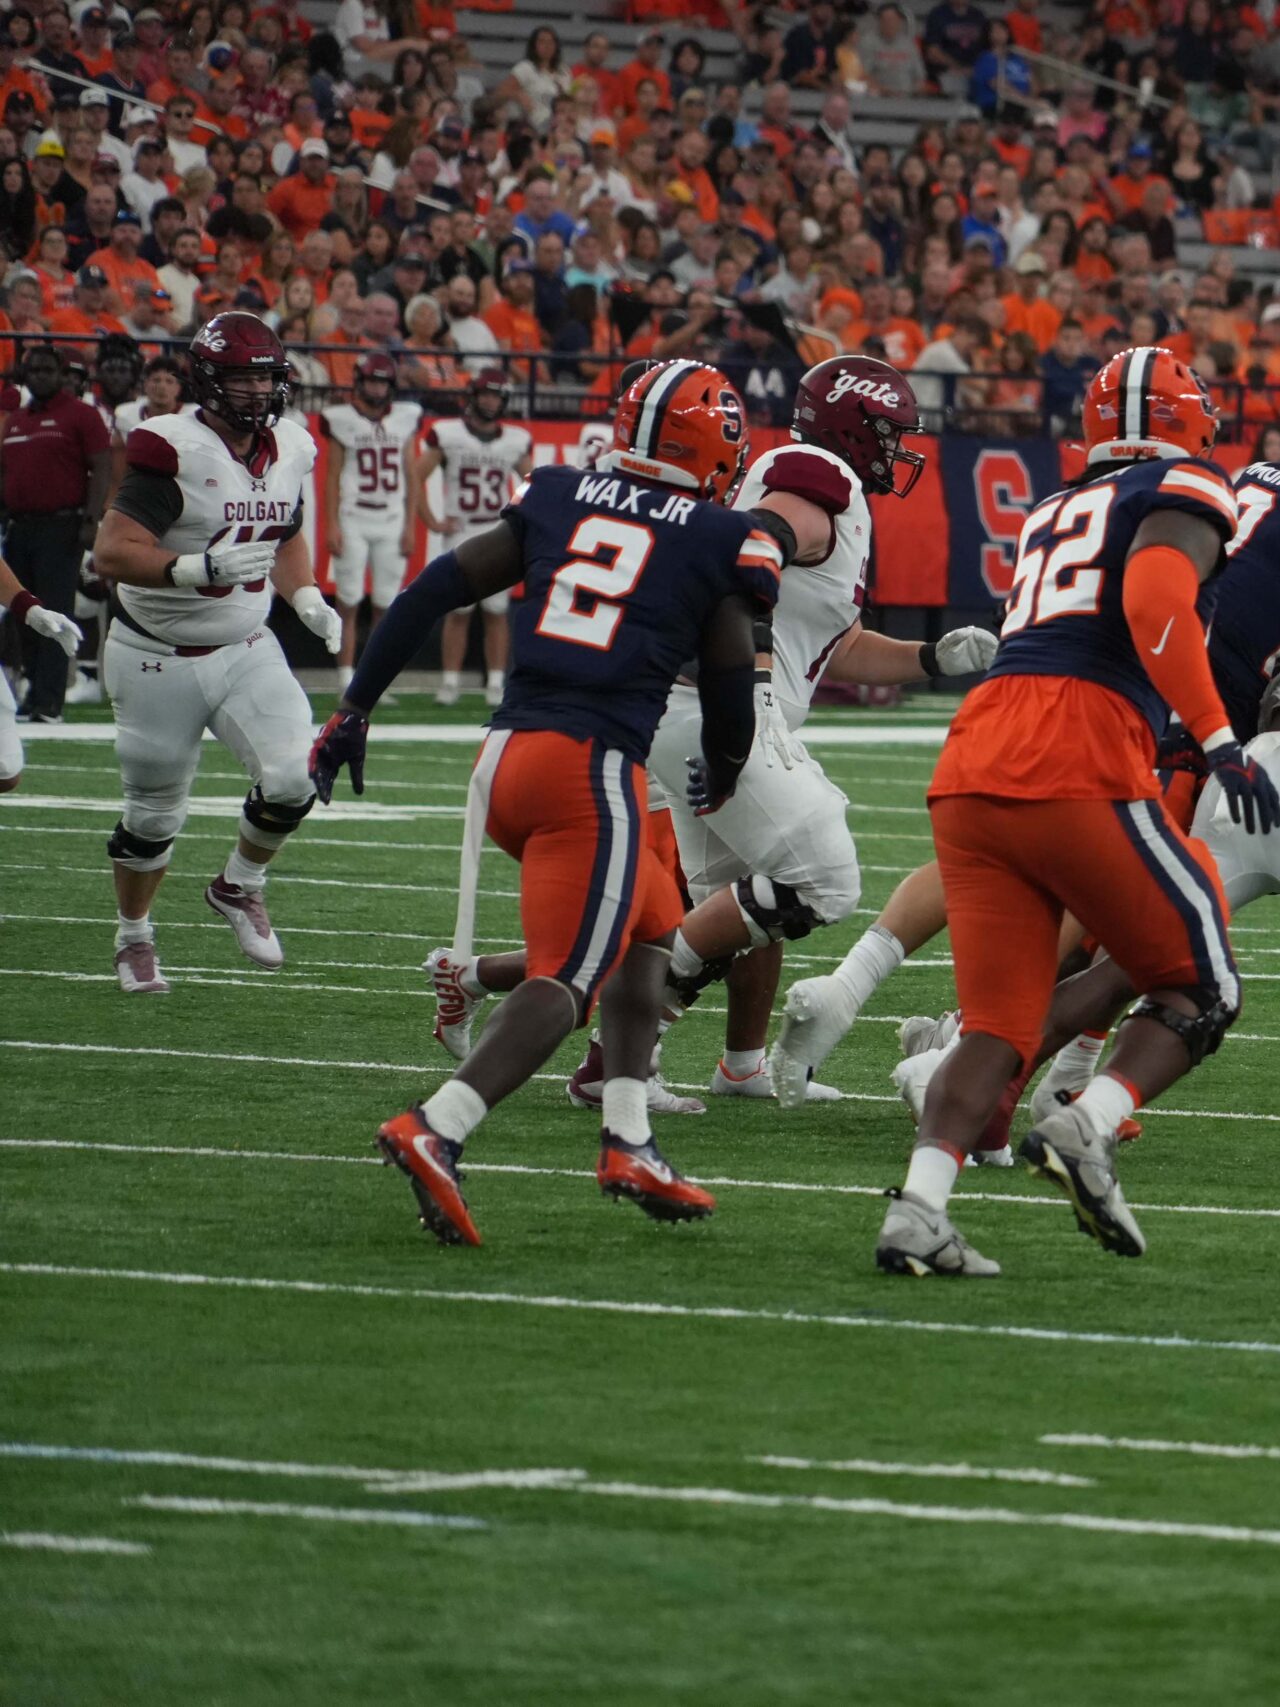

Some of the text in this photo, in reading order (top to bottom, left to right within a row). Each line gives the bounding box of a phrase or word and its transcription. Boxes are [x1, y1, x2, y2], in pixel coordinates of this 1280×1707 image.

[356, 447, 399, 492] 95
[458, 466, 504, 512] 53
[574, 474, 697, 526] WAX JR
[973, 449, 1033, 599] S
[1000, 483, 1117, 639] 52
[535, 514, 655, 652] 2
